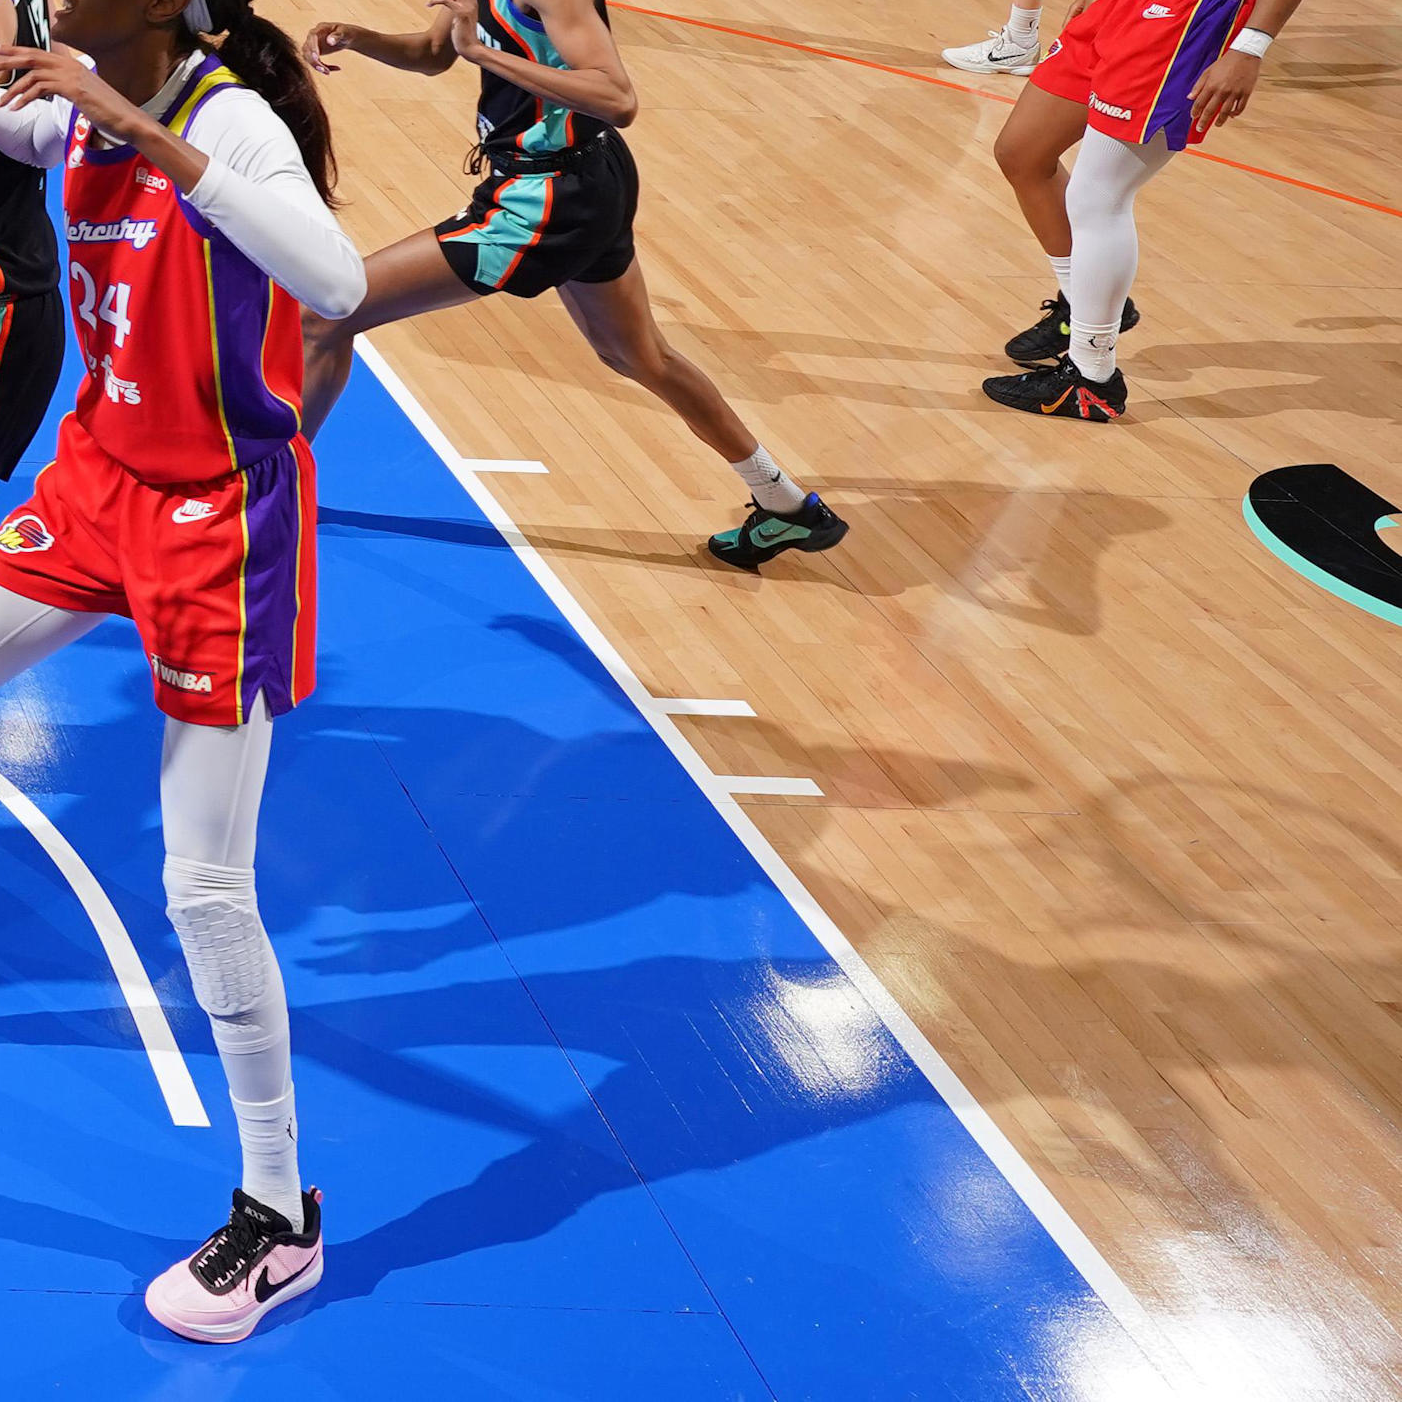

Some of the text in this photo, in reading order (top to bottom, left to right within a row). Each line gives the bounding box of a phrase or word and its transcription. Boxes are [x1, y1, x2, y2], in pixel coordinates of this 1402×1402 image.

[1148, 3, 1172, 16] NIKE
[1095, 99, 1132, 121] WNBA
[136, 168, 168, 192] HERO
[70, 261, 132, 348] 24
[181, 499, 214, 517] NIKE
[160, 667, 212, 693] WNBA
